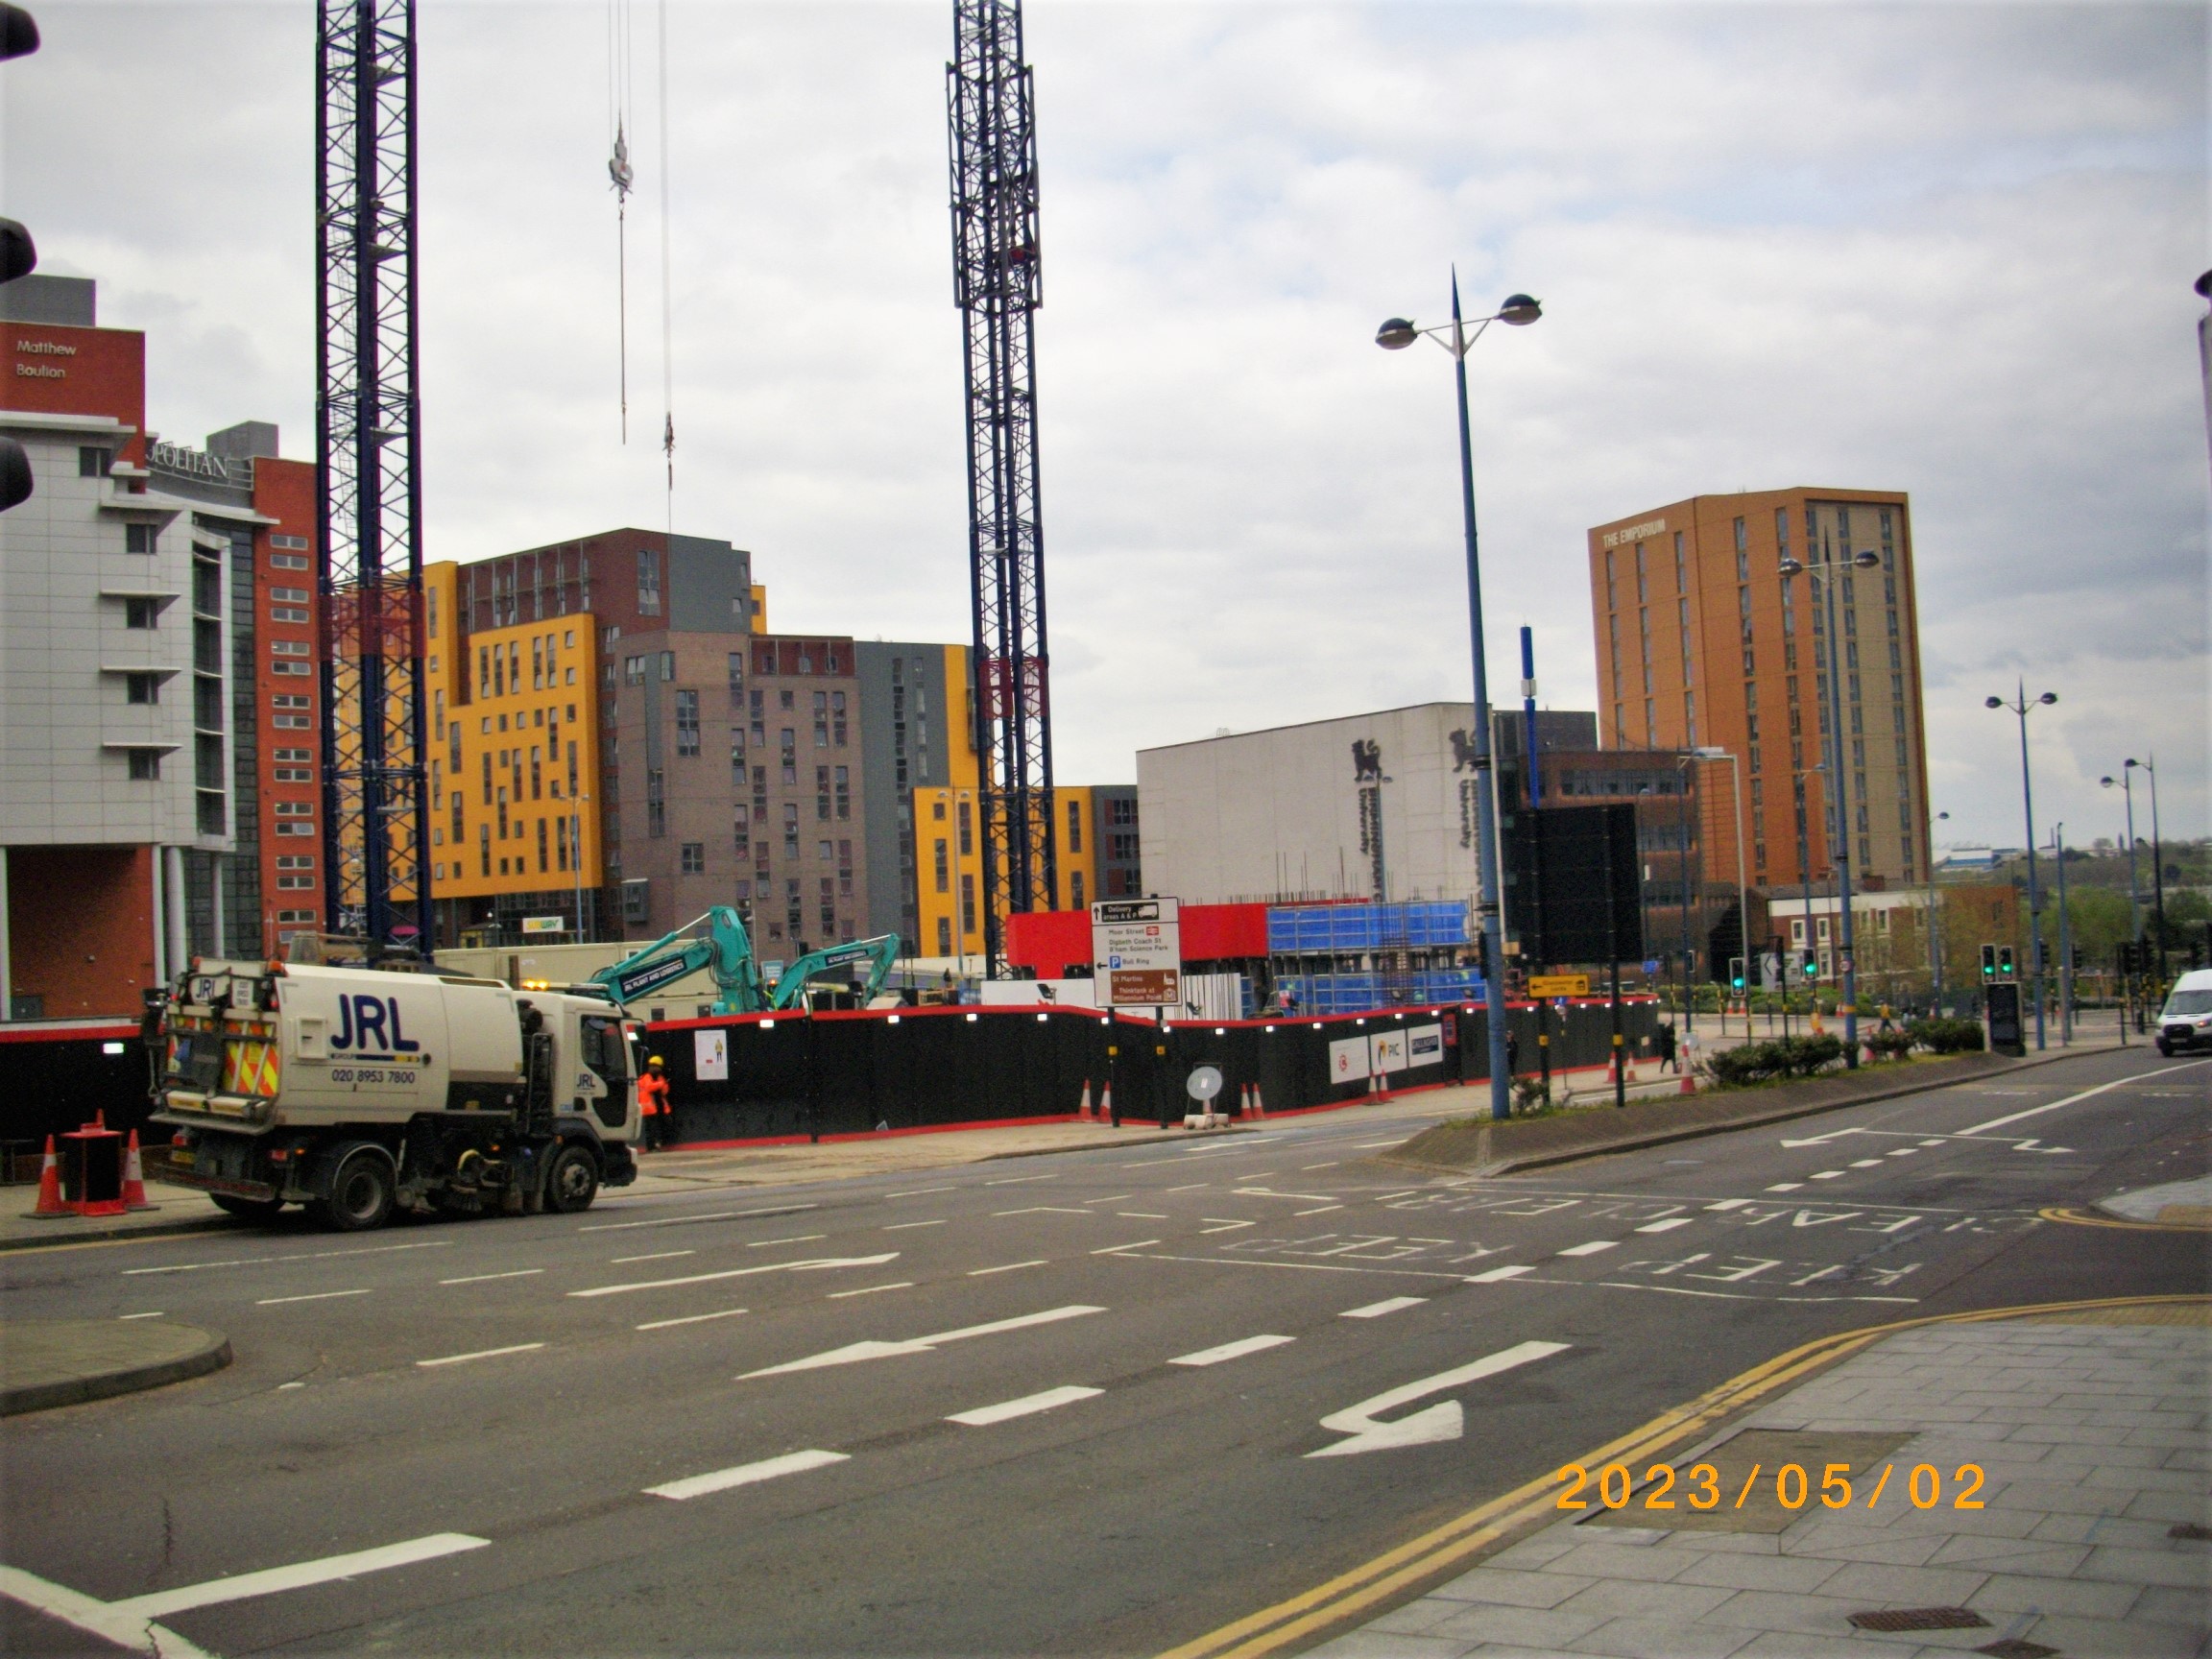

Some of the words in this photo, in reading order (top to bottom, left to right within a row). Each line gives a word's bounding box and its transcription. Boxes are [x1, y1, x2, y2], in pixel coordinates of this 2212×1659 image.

[17, 340, 77, 355] Matthew
[1602, 532, 1619, 549] THE
[1620, 518, 1667, 543] EMPORIUM
[1107, 905, 1132, 914] Delivery
[526, 920, 559, 930] SUBWAY
[330, 993, 420, 1051] JRL
[332, 1070, 353, 1082] 020
[357, 1070, 384, 1083] 8953
[388, 1071, 415, 1083] 7800
[577, 1073, 596, 1088] JRL
